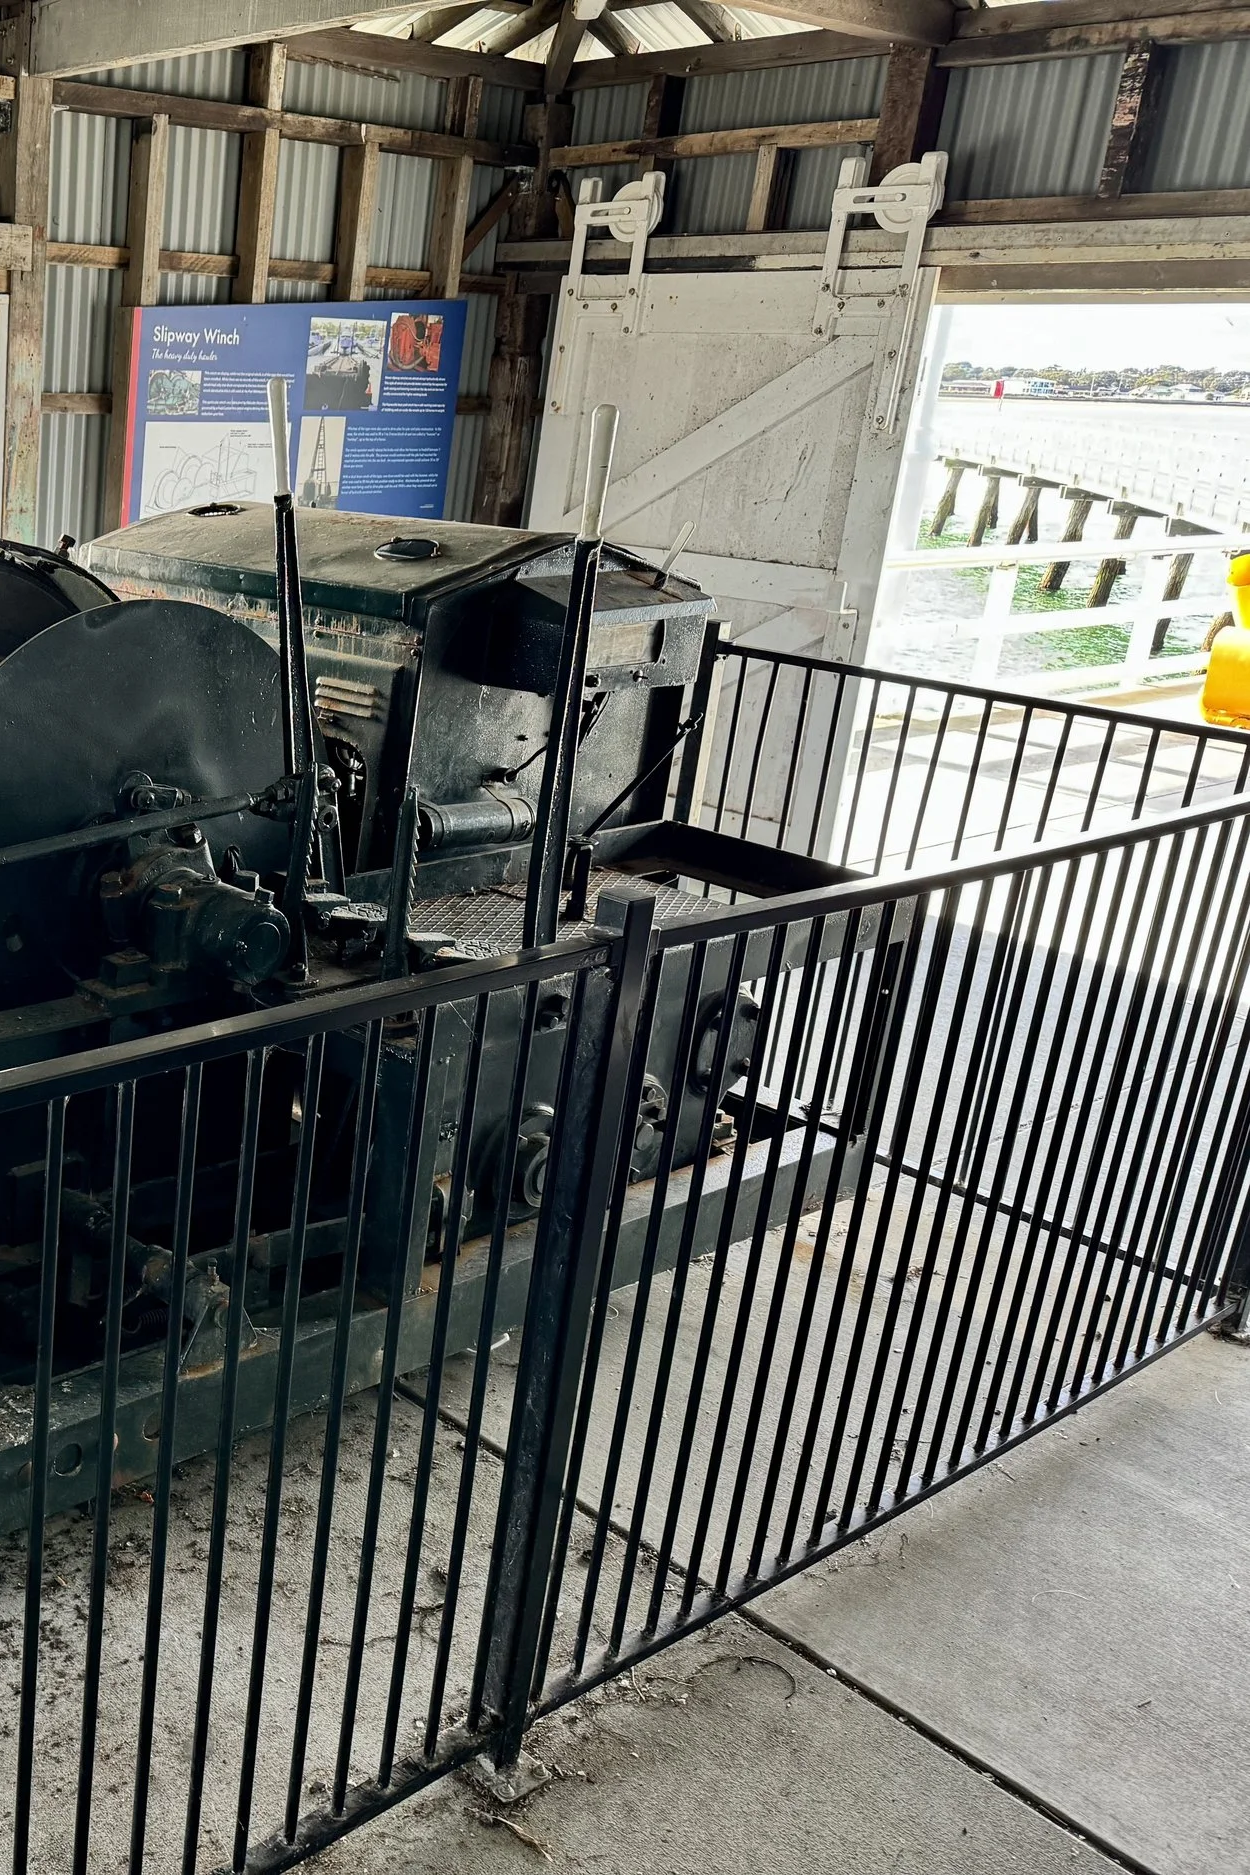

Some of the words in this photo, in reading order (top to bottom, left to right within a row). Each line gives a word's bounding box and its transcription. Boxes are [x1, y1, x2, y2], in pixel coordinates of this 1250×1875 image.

[153, 325, 200, 347] Slipway
[204, 328, 239, 344] Winch
[152, 348, 163, 360] The
[163, 349, 182, 362] heavy
[183, 350, 198, 363] duty
[198, 350, 218, 361] hauler
